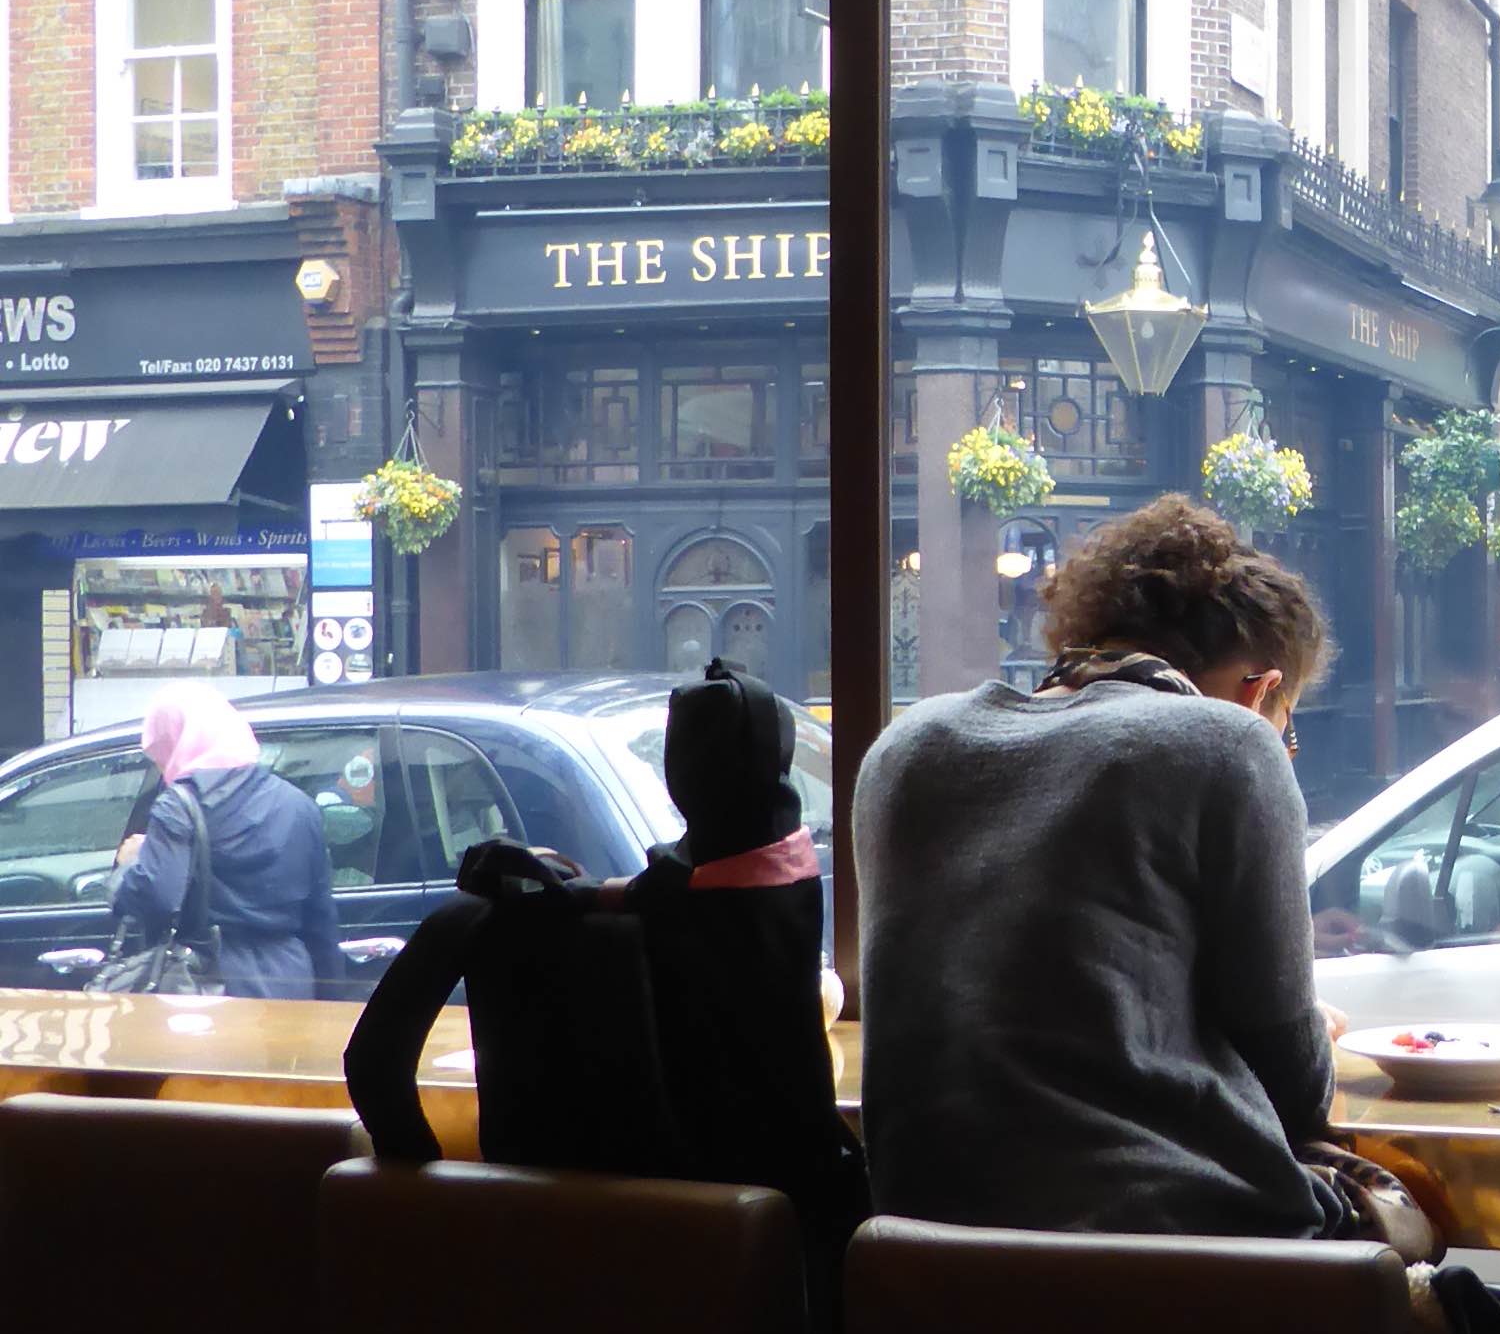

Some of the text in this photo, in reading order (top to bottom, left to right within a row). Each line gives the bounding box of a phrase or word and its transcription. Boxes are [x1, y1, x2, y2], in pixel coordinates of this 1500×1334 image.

[545, 233, 830, 288] THE SHIP
[0, 295, 76, 343] WS
[1348, 302, 1420, 362] THE SHIP
[20, 351, 294, 375] Lotto Tel/Fax: 020 7437 6131
[257, 528, 308, 548] Spirits
